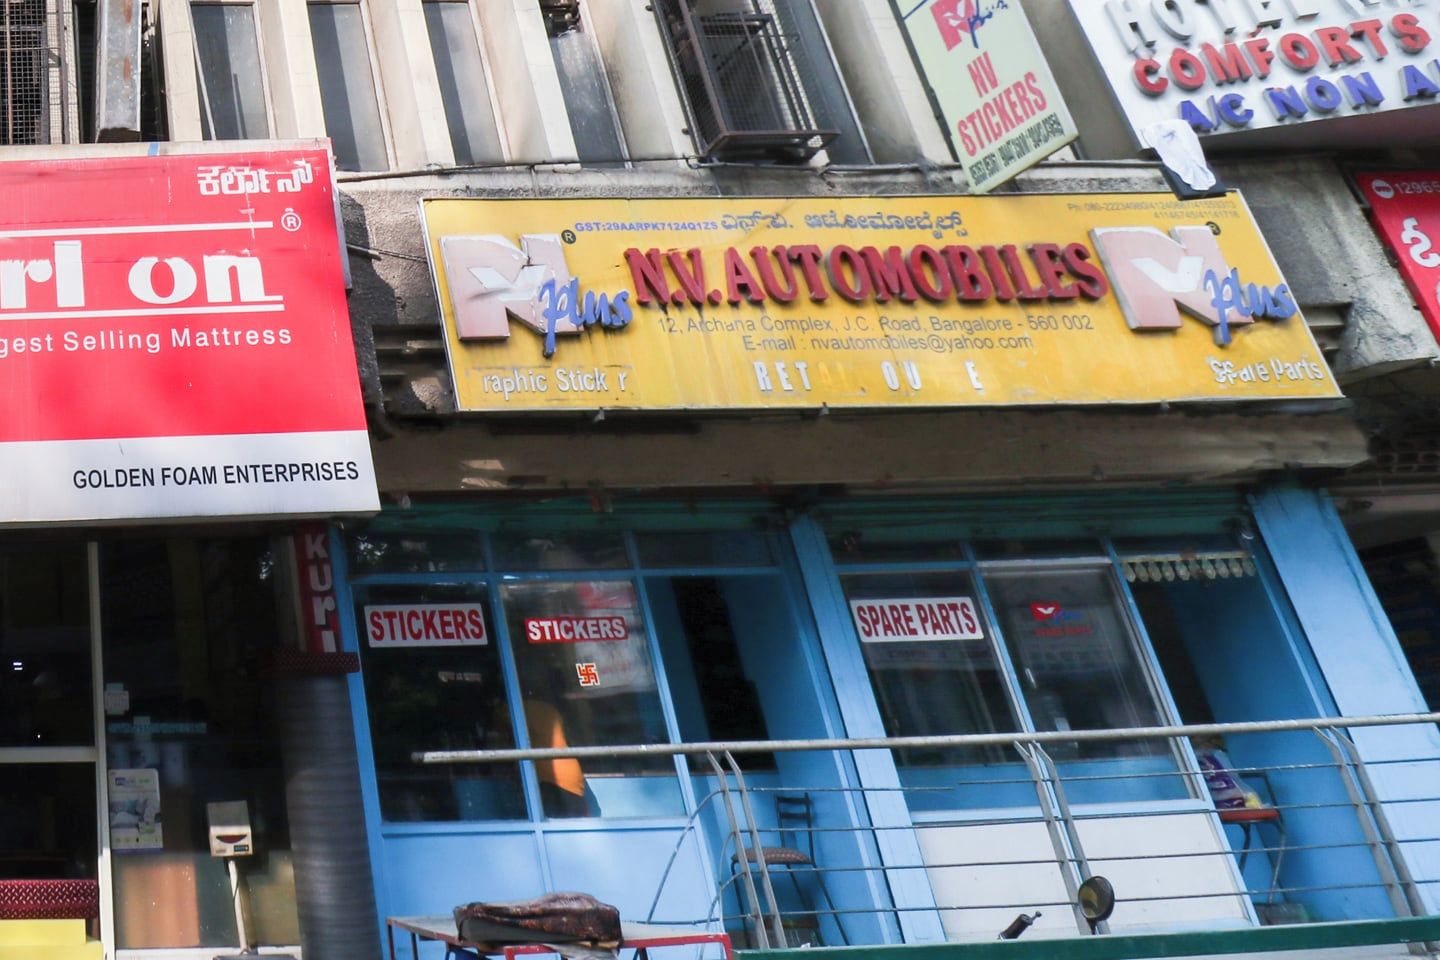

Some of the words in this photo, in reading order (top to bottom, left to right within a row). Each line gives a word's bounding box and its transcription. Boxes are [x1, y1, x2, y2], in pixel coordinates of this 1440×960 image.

[1129, 13, 1431, 96] COMFORTS
[967, 52, 998, 98] NV
[1176, 93, 1253, 133] A/C
[1264, 70, 1385, 122] NON
[1398, 59, 1440, 102] A
[957, 70, 1048, 157] STICKERS
[538, 276, 634, 359] plus
[1202, 267, 1298, 349] plus
[63, 328, 161, 355] Selling
[170, 326, 293, 348] Mattress
[658, 318, 682, 335] 12,
[687, 316, 756, 333] Archana
[761, 315, 839, 335] Complex,
[842, 316, 870, 333] J.C.
[879, 315, 927, 334] Road,
[931, 315, 1013, 337] Bangalore
[1027, 314, 1058, 331] 560
[1062, 314, 1095, 331] 002
[743, 335, 796, 353] E-mail
[810, 334, 1034, 355] nvautomobiles@yahoo.com
[554, 367, 628, 393] Stickr
[1269, 357, 1325, 382] Parts
[73, 467, 156, 490] GOLDEN
[160, 465, 219, 488] FOAM
[223, 459, 359, 486] ENTERPRISES
[369, 609, 484, 641] STICKERS
[527, 617, 626, 641] STICKERS
[857, 603, 919, 639] SPARE
[920, 601, 978, 637] PARTS
